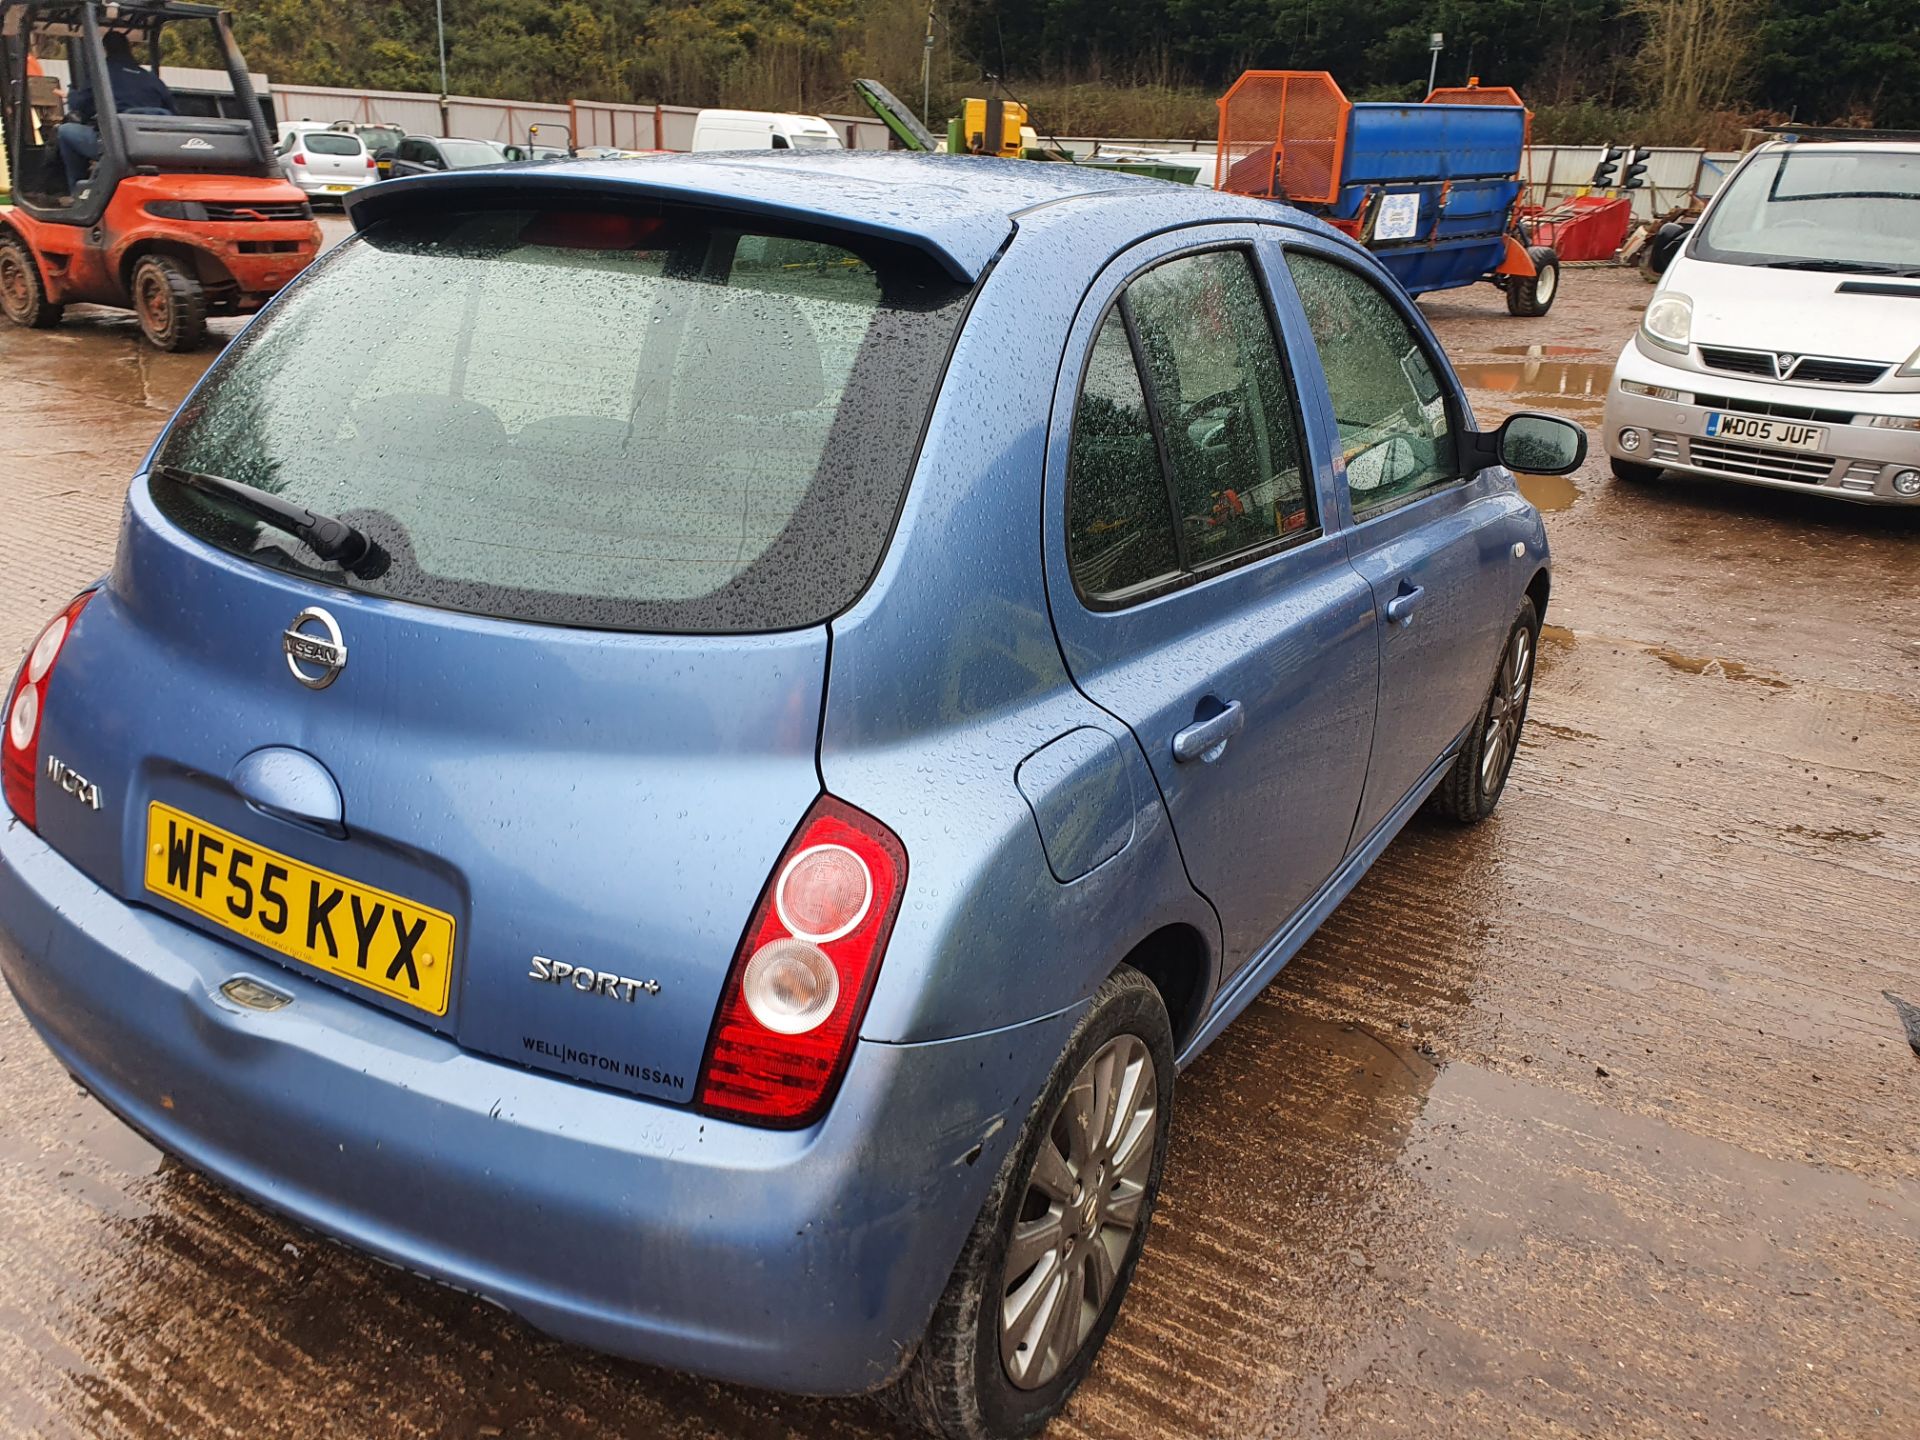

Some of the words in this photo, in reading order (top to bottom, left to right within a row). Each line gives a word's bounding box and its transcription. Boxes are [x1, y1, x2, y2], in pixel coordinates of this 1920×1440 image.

[1721, 416, 1773, 439] WD05
[1776, 426, 1818, 445] JUF
[285, 637, 337, 664] NISSAN
[167, 820, 288, 935] WF55
[306, 880, 427, 991] KYX
[523, 1037, 620, 1073] WELLINGTON
[624, 1063, 684, 1089] NISSAN
